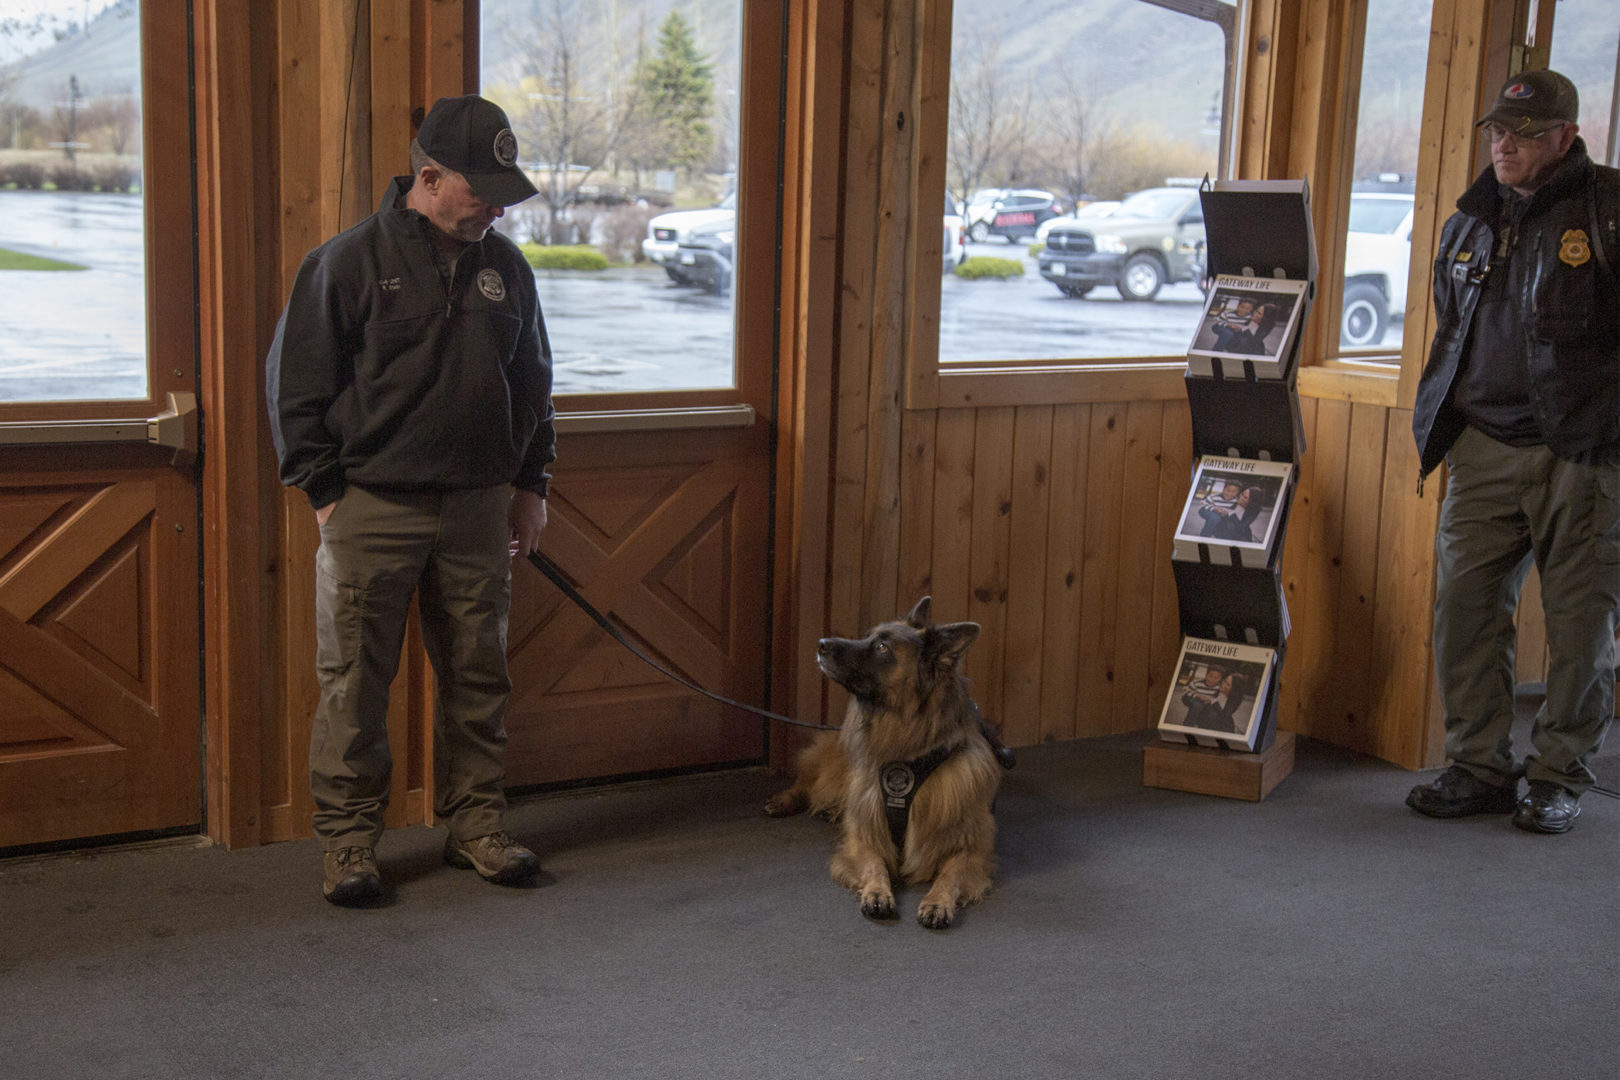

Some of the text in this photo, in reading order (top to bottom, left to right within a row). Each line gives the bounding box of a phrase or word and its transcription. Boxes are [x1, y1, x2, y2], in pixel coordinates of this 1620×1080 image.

[1218, 277, 1272, 290] GATEWAY LIFE
[1203, 458, 1257, 472] GATEWAY LIFE
[1186, 640, 1239, 657] GATEWAY LIFE
